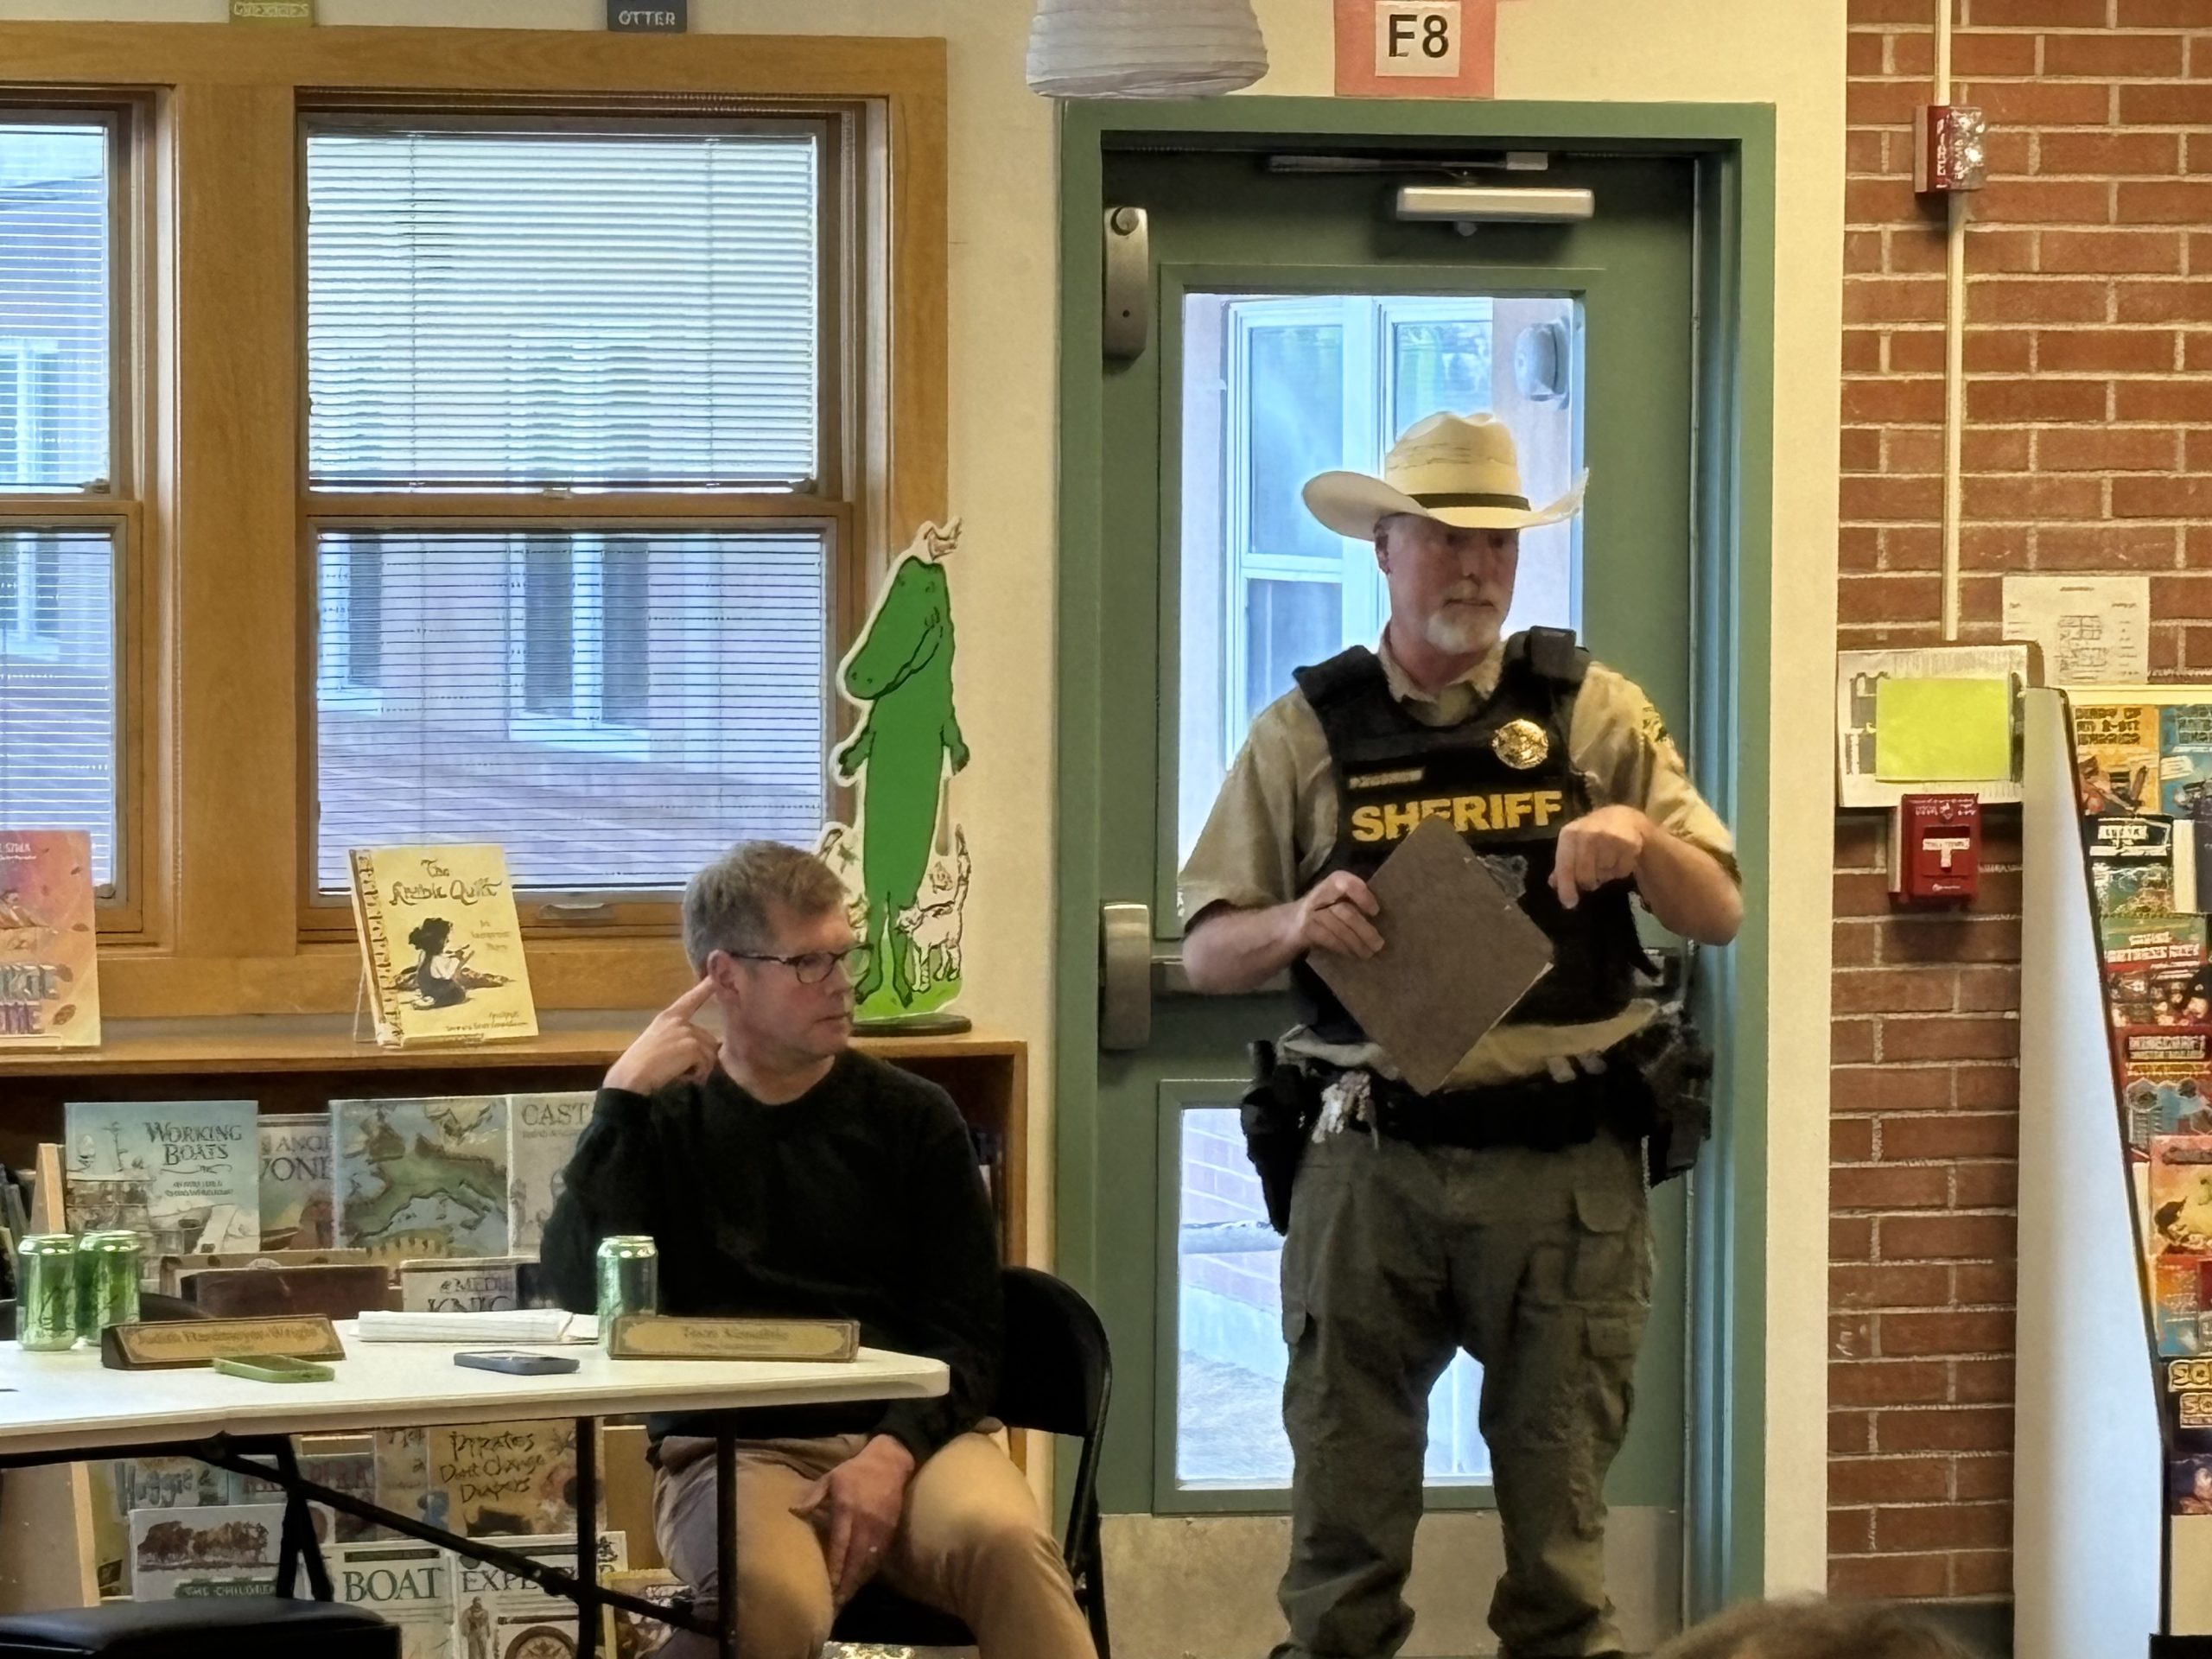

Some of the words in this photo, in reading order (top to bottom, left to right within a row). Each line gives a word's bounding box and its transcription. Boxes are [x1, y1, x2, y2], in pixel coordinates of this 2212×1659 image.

[618, 10, 676, 26] OTTER
[1389, 14, 1449, 58] F8
[1351, 791, 1562, 842] SHERIFF
[521, 1103, 589, 1126] CAST
[144, 1122, 243, 1143] WORKING
[162, 1143, 228, 1166] BOATS
[342, 1567, 444, 1602] BOAT
